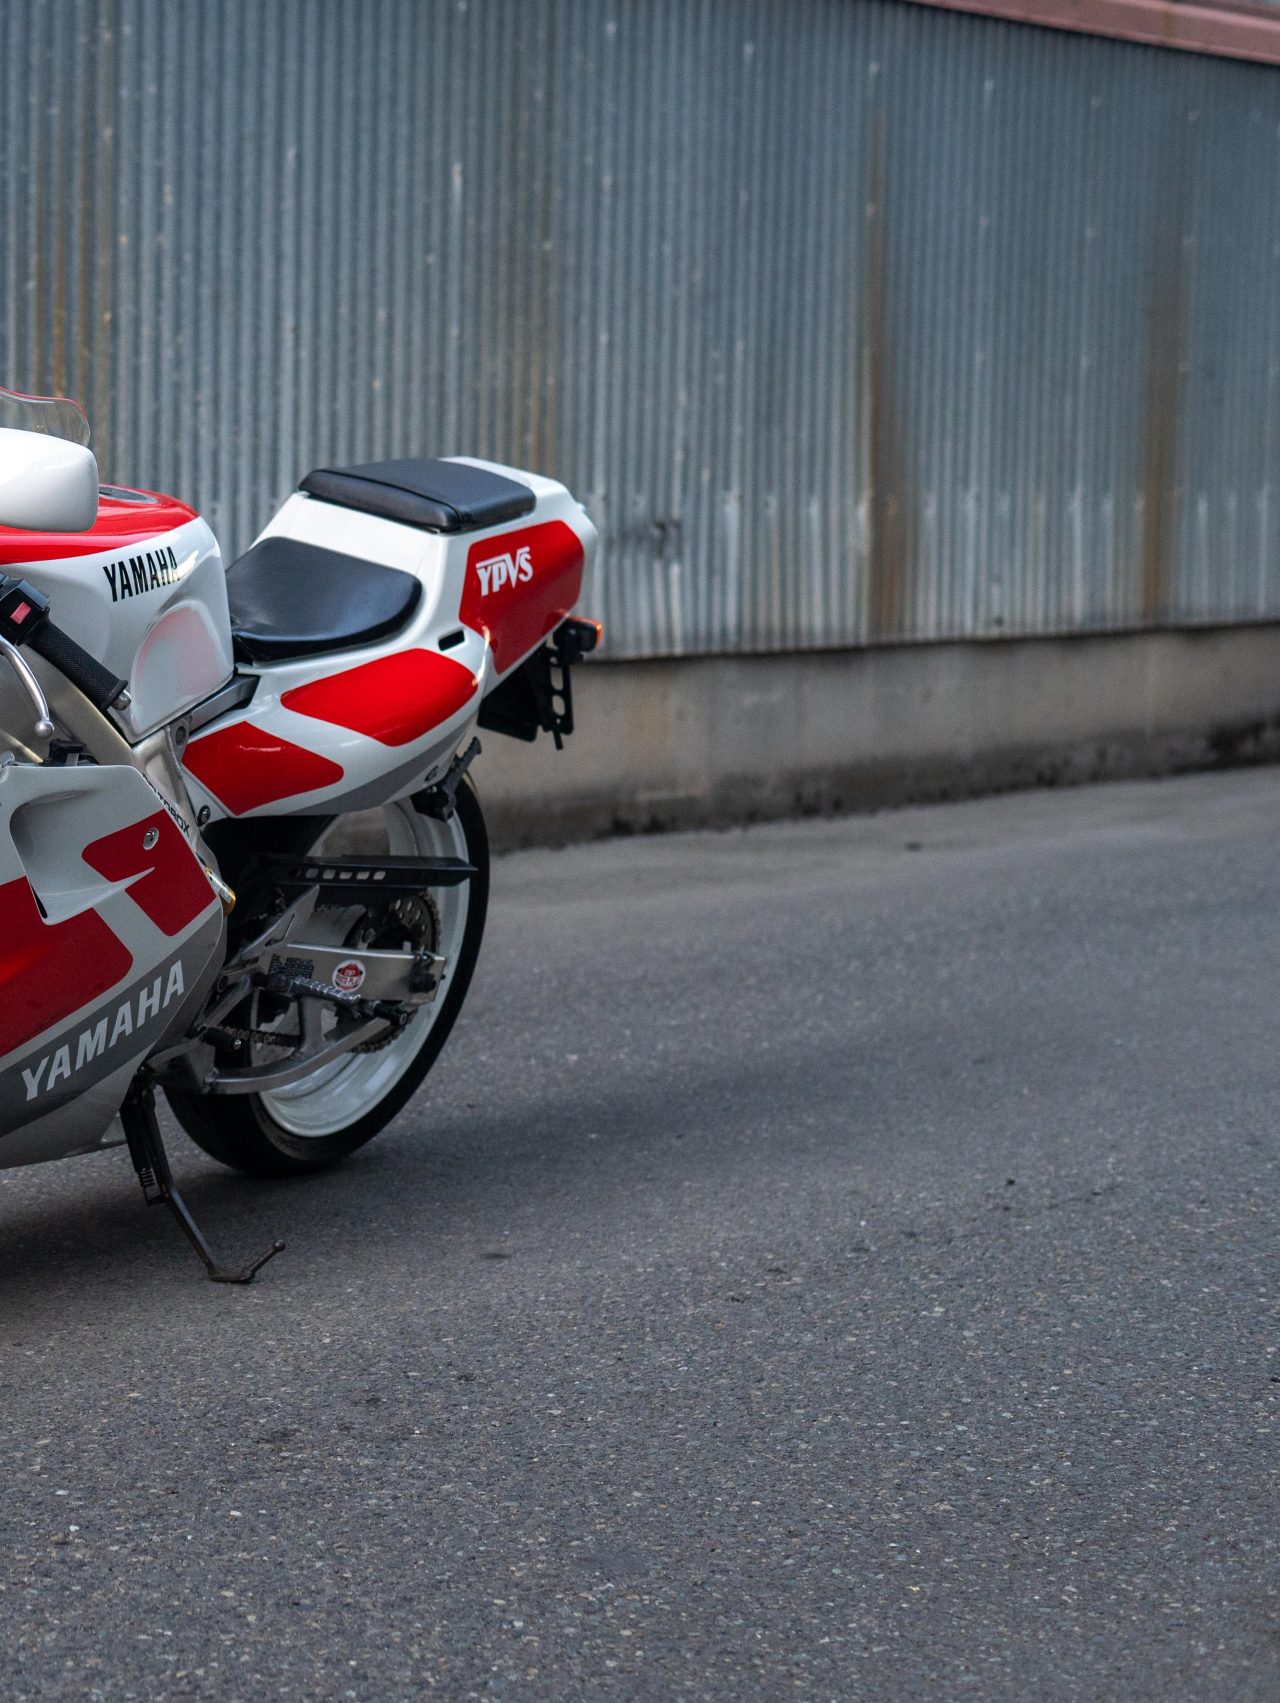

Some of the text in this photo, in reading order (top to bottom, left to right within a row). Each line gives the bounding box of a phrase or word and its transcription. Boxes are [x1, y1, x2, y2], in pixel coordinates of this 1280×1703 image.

[102, 546, 181, 603] YAMAHA
[475, 545, 534, 597] YPVS
[21, 959, 185, 1101] YAMAHA
